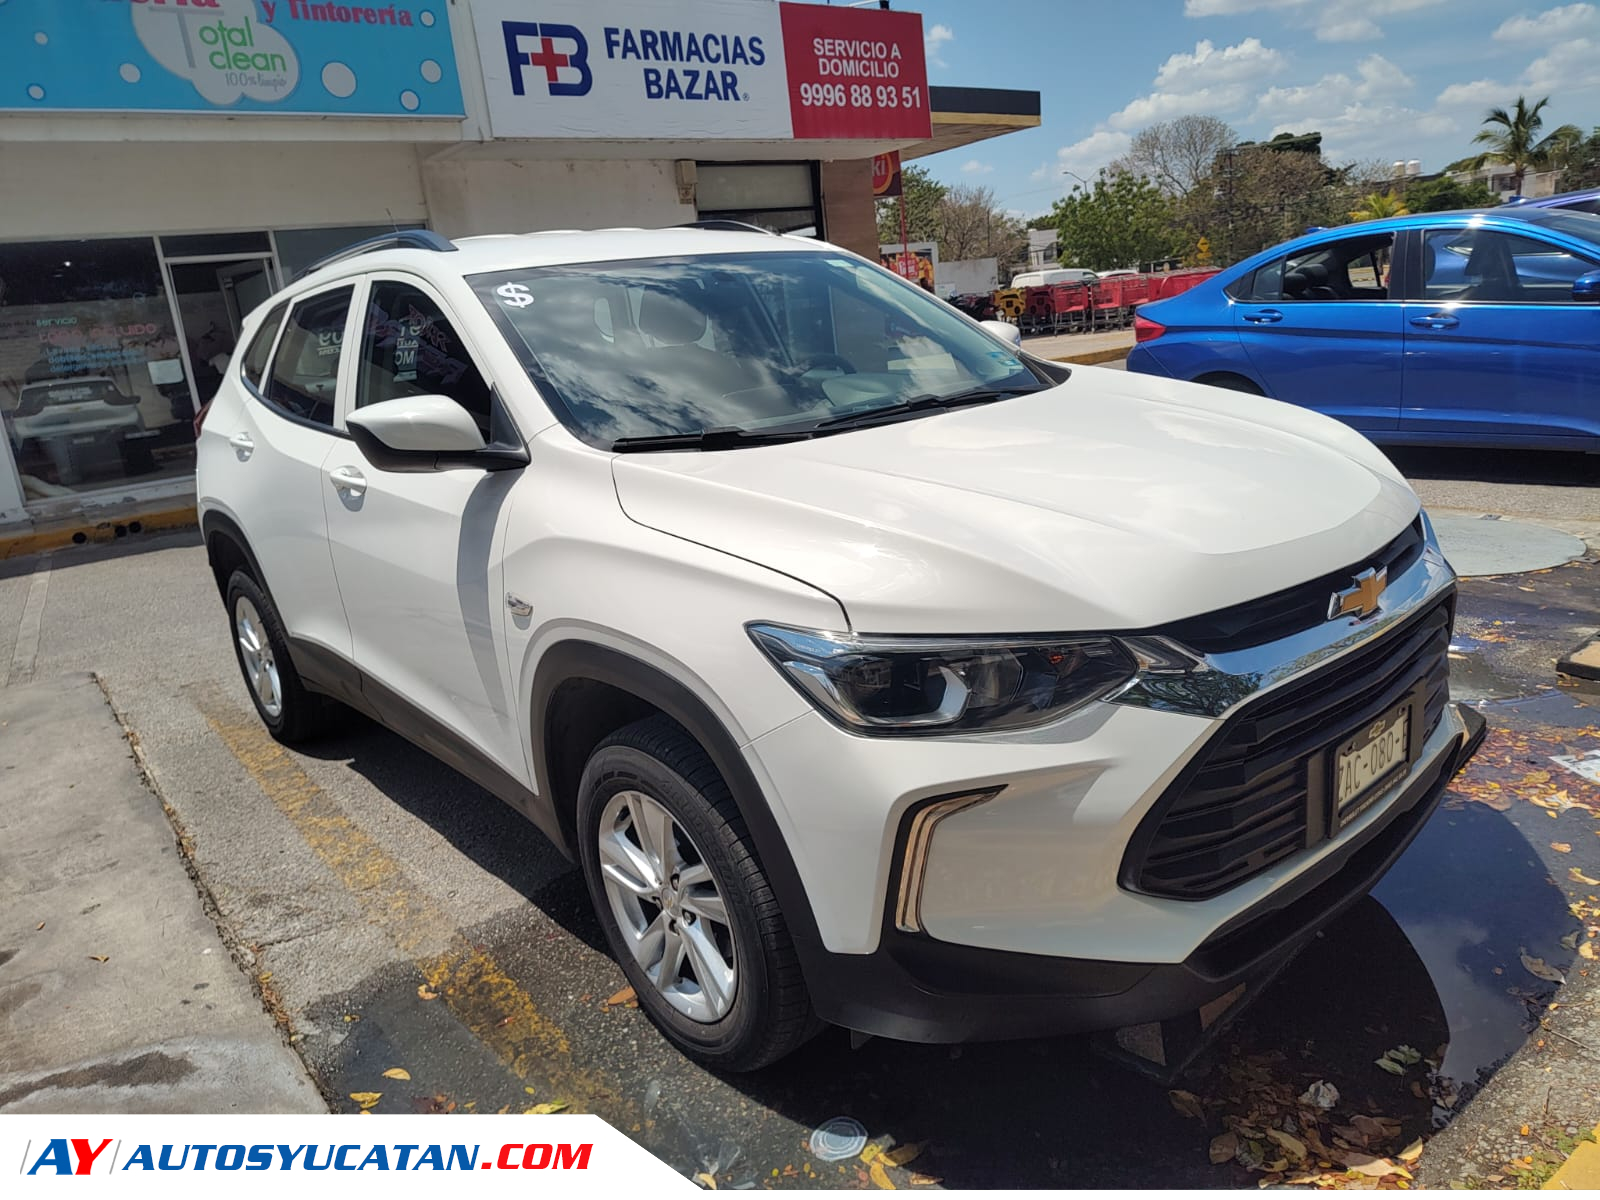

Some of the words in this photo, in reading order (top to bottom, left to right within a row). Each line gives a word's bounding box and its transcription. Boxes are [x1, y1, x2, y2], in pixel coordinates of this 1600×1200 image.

[261, 0, 276, 23] y
[288, 0, 413, 26] Tintorería
[603, 27, 765, 66] FARMACIAS
[813, 37, 887, 59] SERVICIO
[890, 43, 902, 59] A
[209, 50, 287, 72] clean
[818, 58, 899, 78] DOMICILIO
[643, 67, 741, 101] BAZAR
[800, 82, 846, 107] 9996
[850, 84, 872, 107] 88
[876, 85, 898, 108] 93
[902, 86, 920, 108] 51
